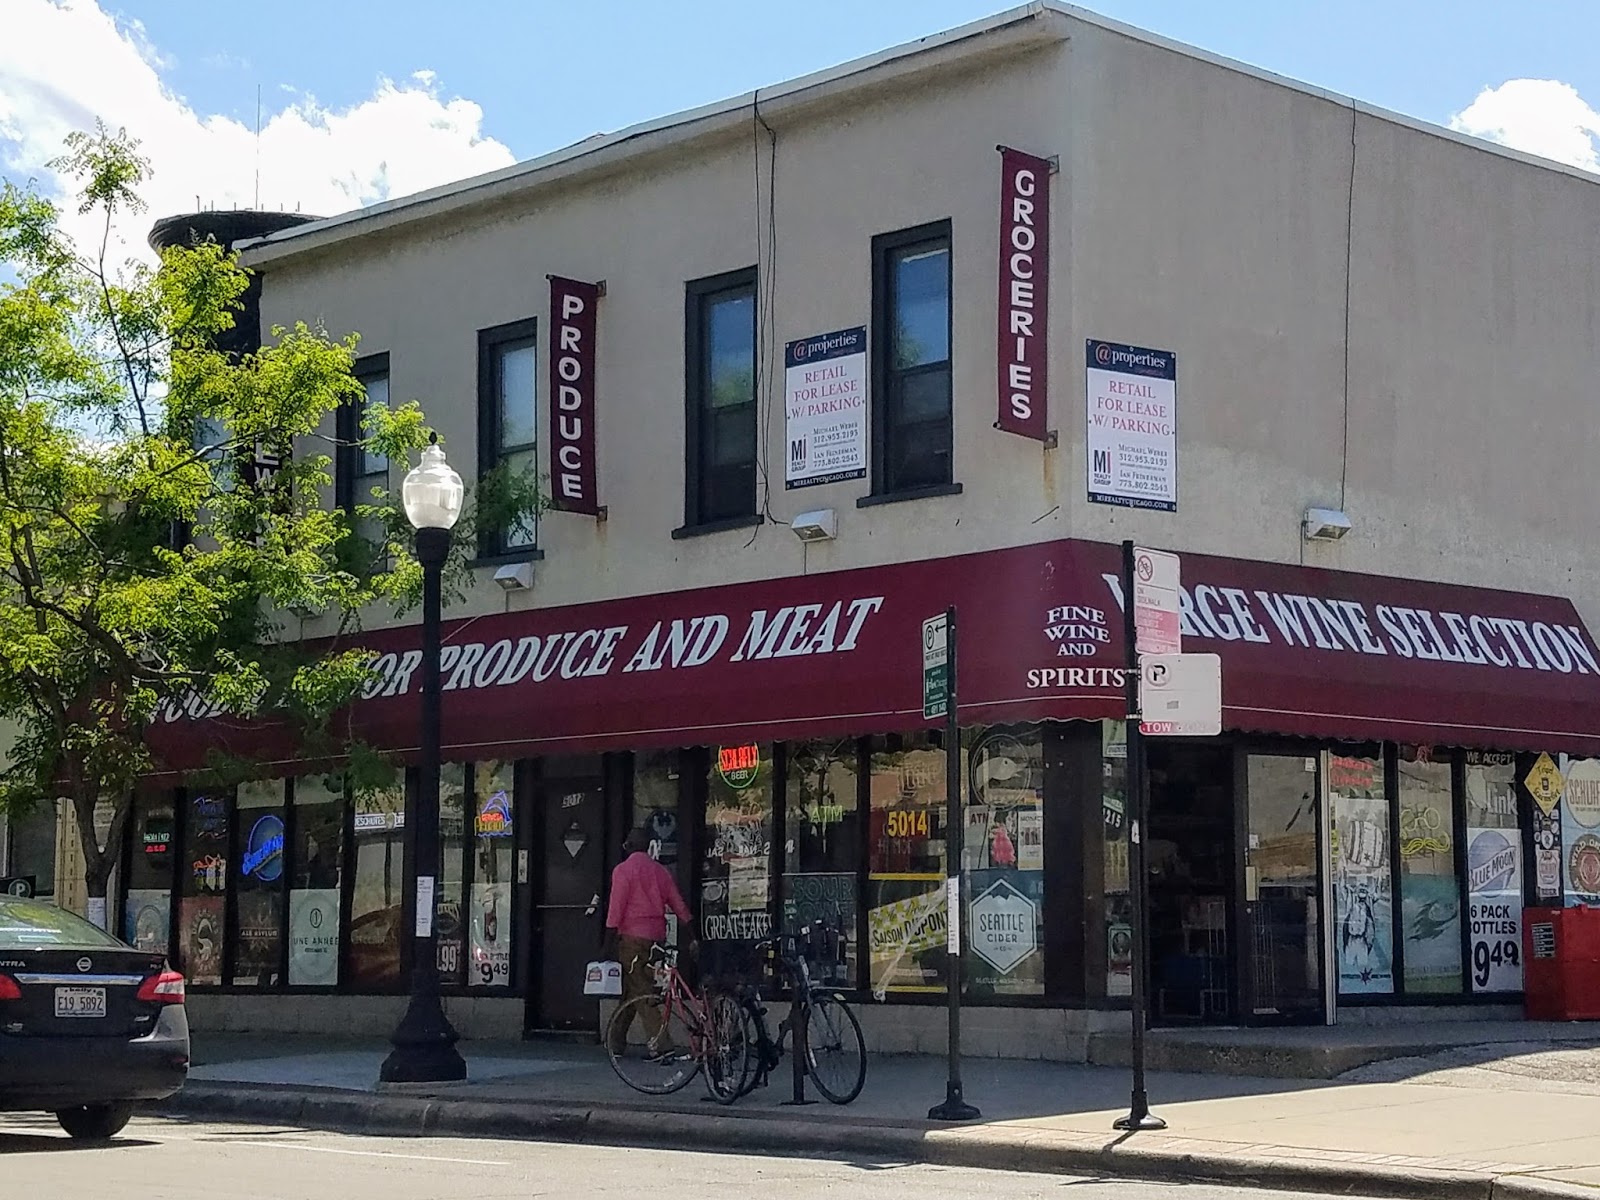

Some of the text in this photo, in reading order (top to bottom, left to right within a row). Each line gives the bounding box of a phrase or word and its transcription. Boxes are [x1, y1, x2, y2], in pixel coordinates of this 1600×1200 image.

[1009, 169, 1035, 420] GROCERIES
[805, 365, 847, 384] RETAIL
[558, 294, 584, 499] PRODUCE
[794, 379, 858, 402] FOR LEASE
[1109, 380, 1156, 399] RETAIL
[791, 396, 861, 419] W/ PARKING
[1097, 397, 1167, 418] FOR LEASE
[1093, 414, 1170, 436] W/ PARKING
[1047, 606, 1106, 625] FINE
[1044, 624, 1111, 644] WINE
[1253, 590, 1388, 656] WINE
[1375, 604, 1600, 676] SELECTION
[352, 597, 885, 700] OR PRODUCE AND MEAT
[1056, 643, 1097, 657] AND
[1026, 668, 1126, 689] SPIRITS
[1145, 722, 1172, 732] TOW
[1466, 751, 1512, 763] WE ACCEPT
[810, 805, 844, 823] ATM
[887, 810, 928, 837] 5014
[1491, 850, 1515, 875] MOON
[1470, 905, 1510, 918] 6 PACK
[705, 914, 740, 940] GREAT
[980, 913, 1024, 933] SEATTLE
[1470, 921, 1517, 935] OTTLES
[987, 933, 1018, 943] CIDER
[58, 996, 75, 1011] E19
